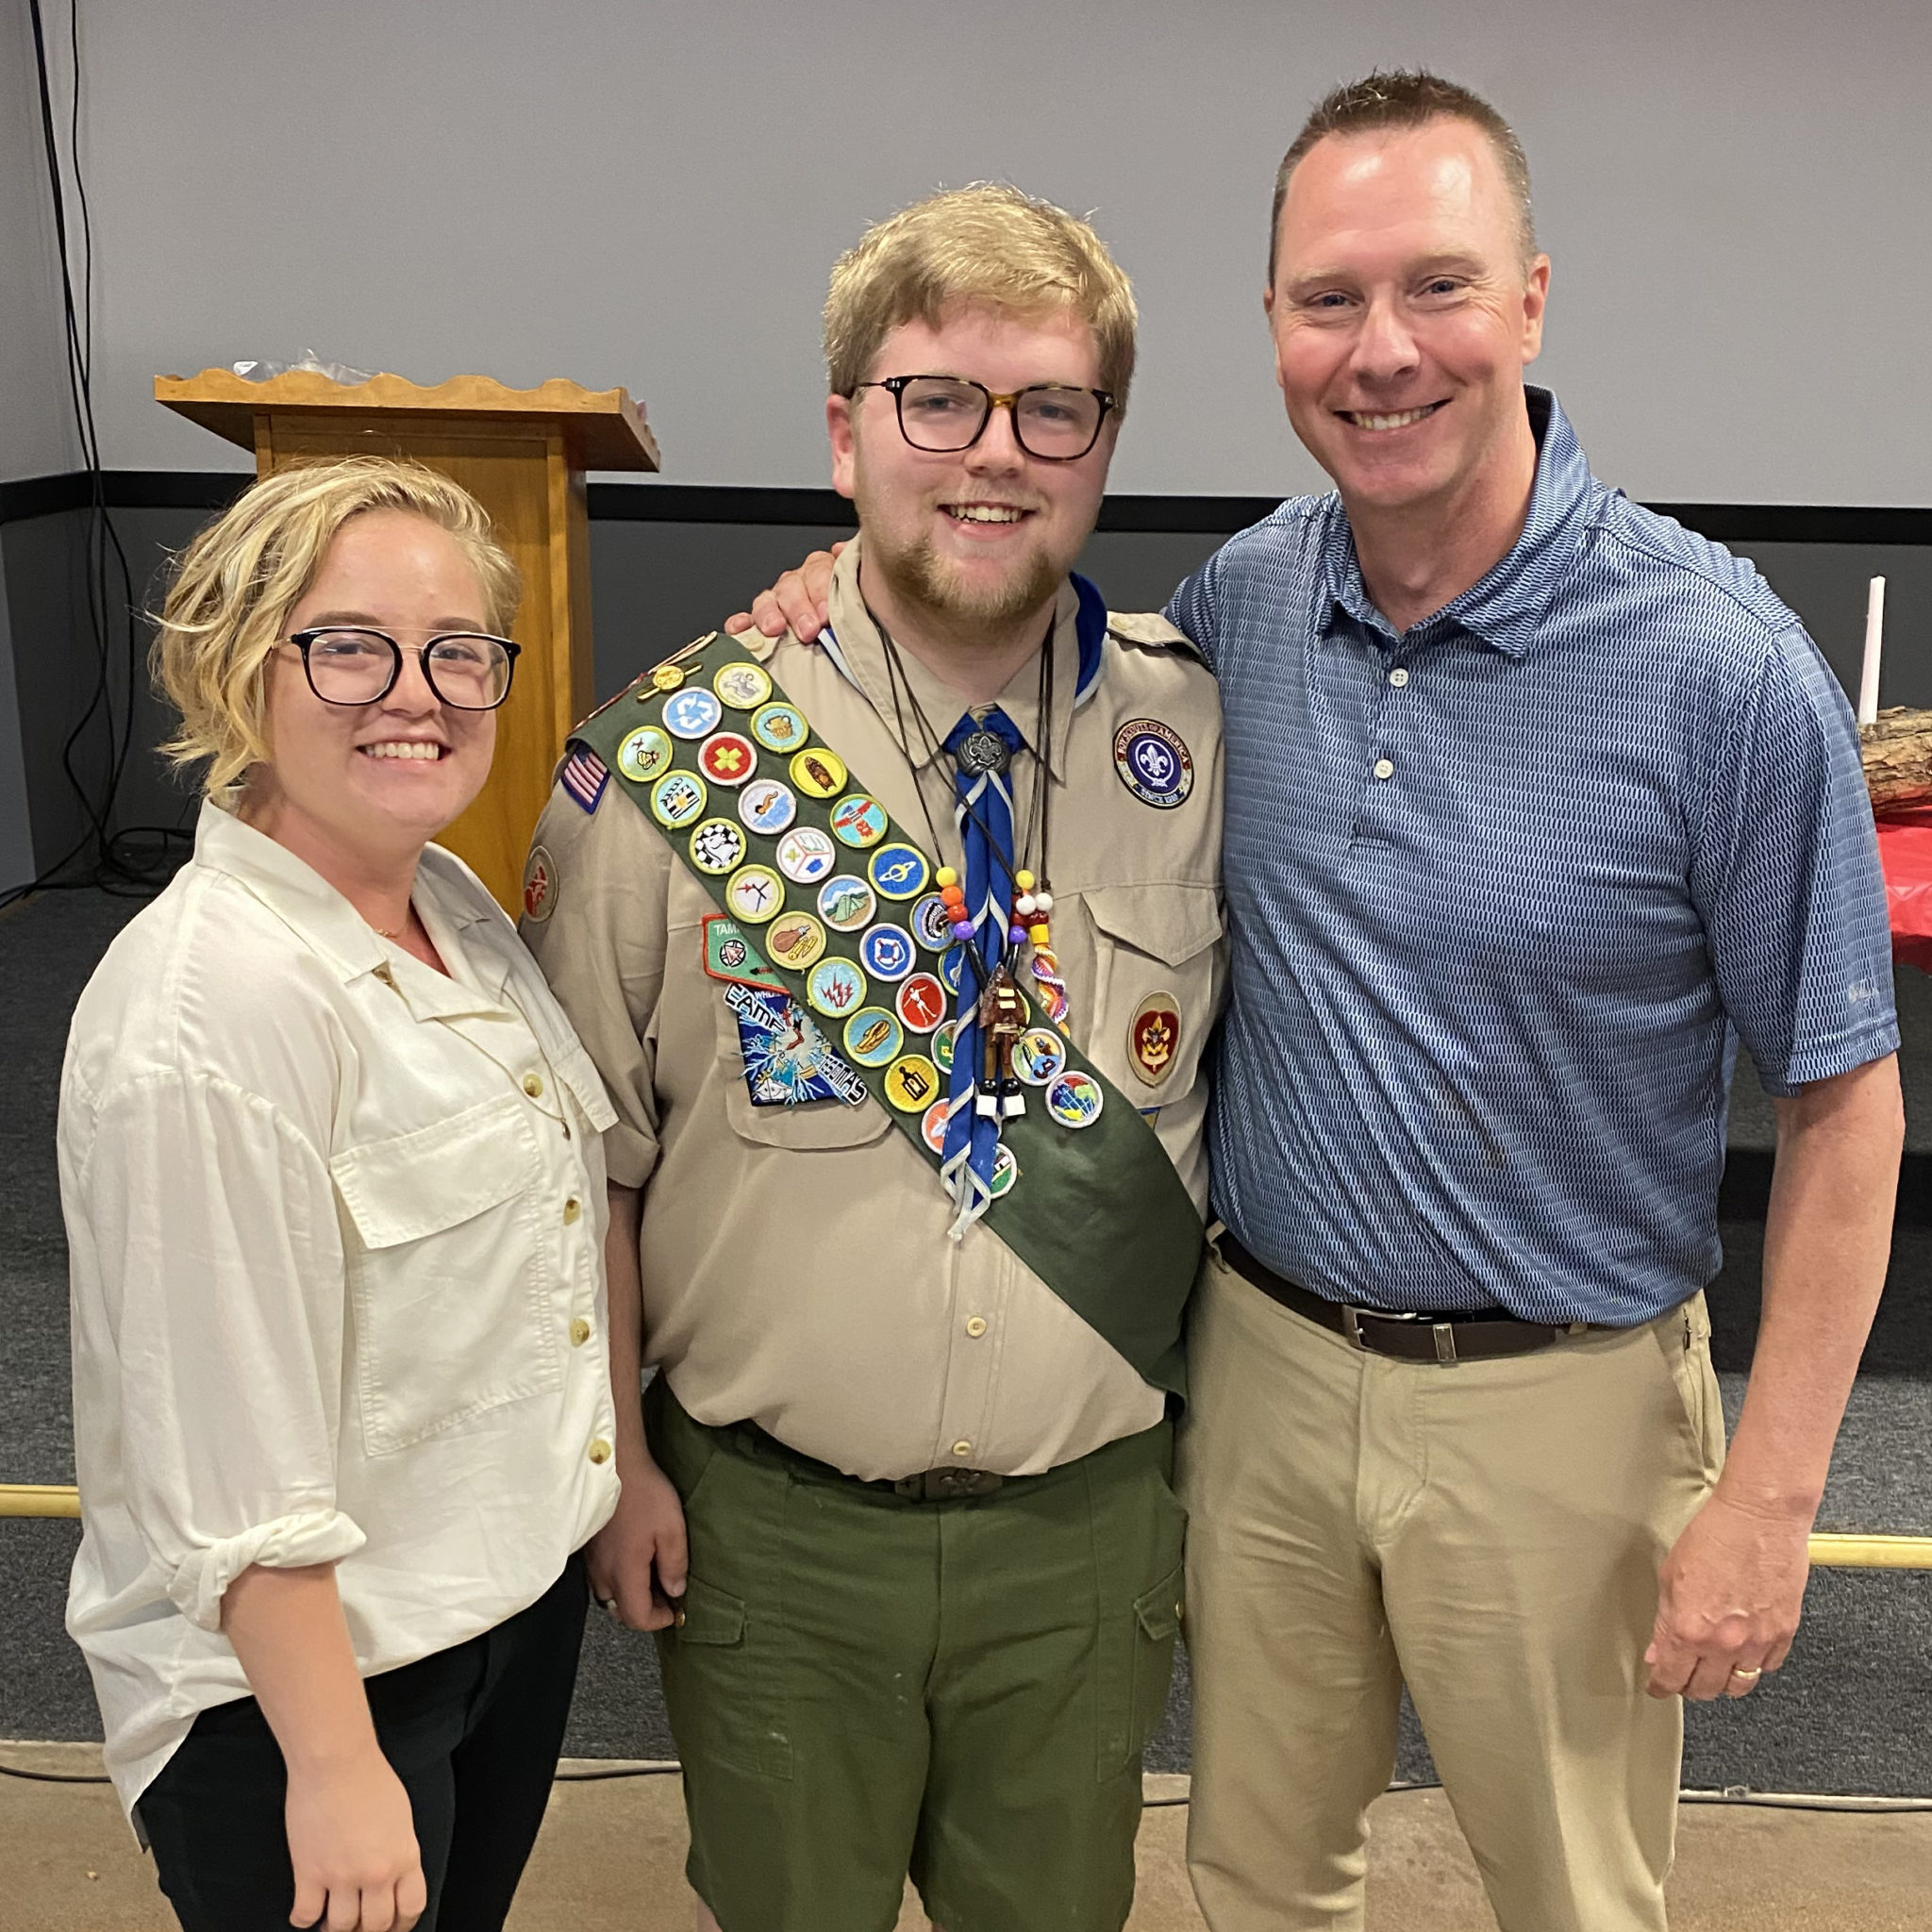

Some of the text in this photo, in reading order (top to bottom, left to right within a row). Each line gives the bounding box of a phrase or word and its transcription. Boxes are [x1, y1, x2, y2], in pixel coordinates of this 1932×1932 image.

[1123, 723, 1148, 739] SCOUTS
[1158, 727, 1189, 763] AMERICA
[713, 924, 740, 937] TAM
